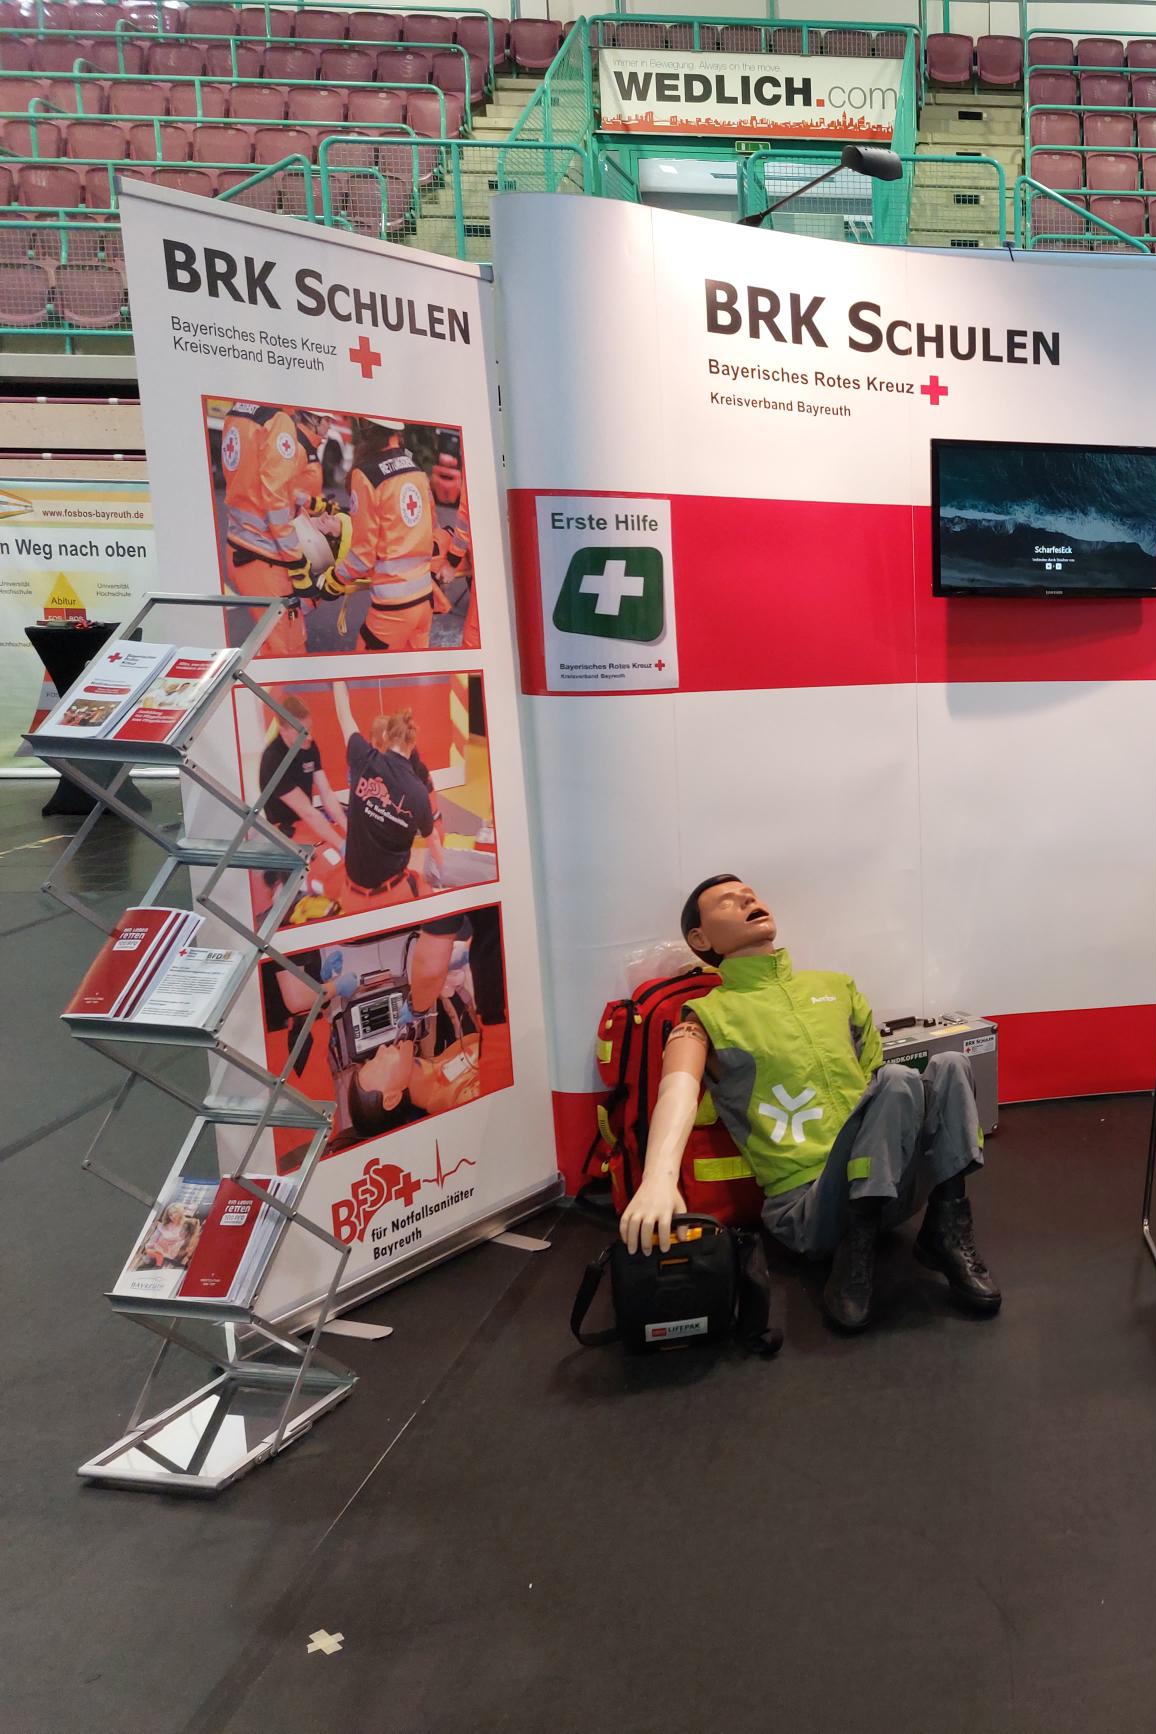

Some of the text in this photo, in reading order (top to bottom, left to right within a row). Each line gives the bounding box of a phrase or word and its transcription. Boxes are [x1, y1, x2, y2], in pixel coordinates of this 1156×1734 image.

[700, 62, 726, 71] Always
[742, 62, 755, 71] the
[614, 71, 897, 109] WEDLICH.com
[163, 238, 471, 345] BRK SCHULEN
[170, 315, 338, 356] Bayerisches Rotes Kreuz
[704, 278, 1060, 366] BRK SCHULEN
[173, 336, 325, 372] Kreisverband Bayreuth
[708, 358, 915, 394] Bayerisches Rotes Kreuz
[710, 391, 851, 417] Kreisverband Bayreuth
[42, 508, 144, 520] www.fosbos-bayreuth.de
[551, 512, 658, 531] Erste Hilfe
[15, 539, 52, 560] Weg
[58, 541, 99, 557] nach
[105, 541, 147, 558] oben
[51, 597, 76, 606] Abitur
[371, 1187, 475, 1242] für Notfallsanitäter
[373, 1228, 422, 1260] Bayreuth
